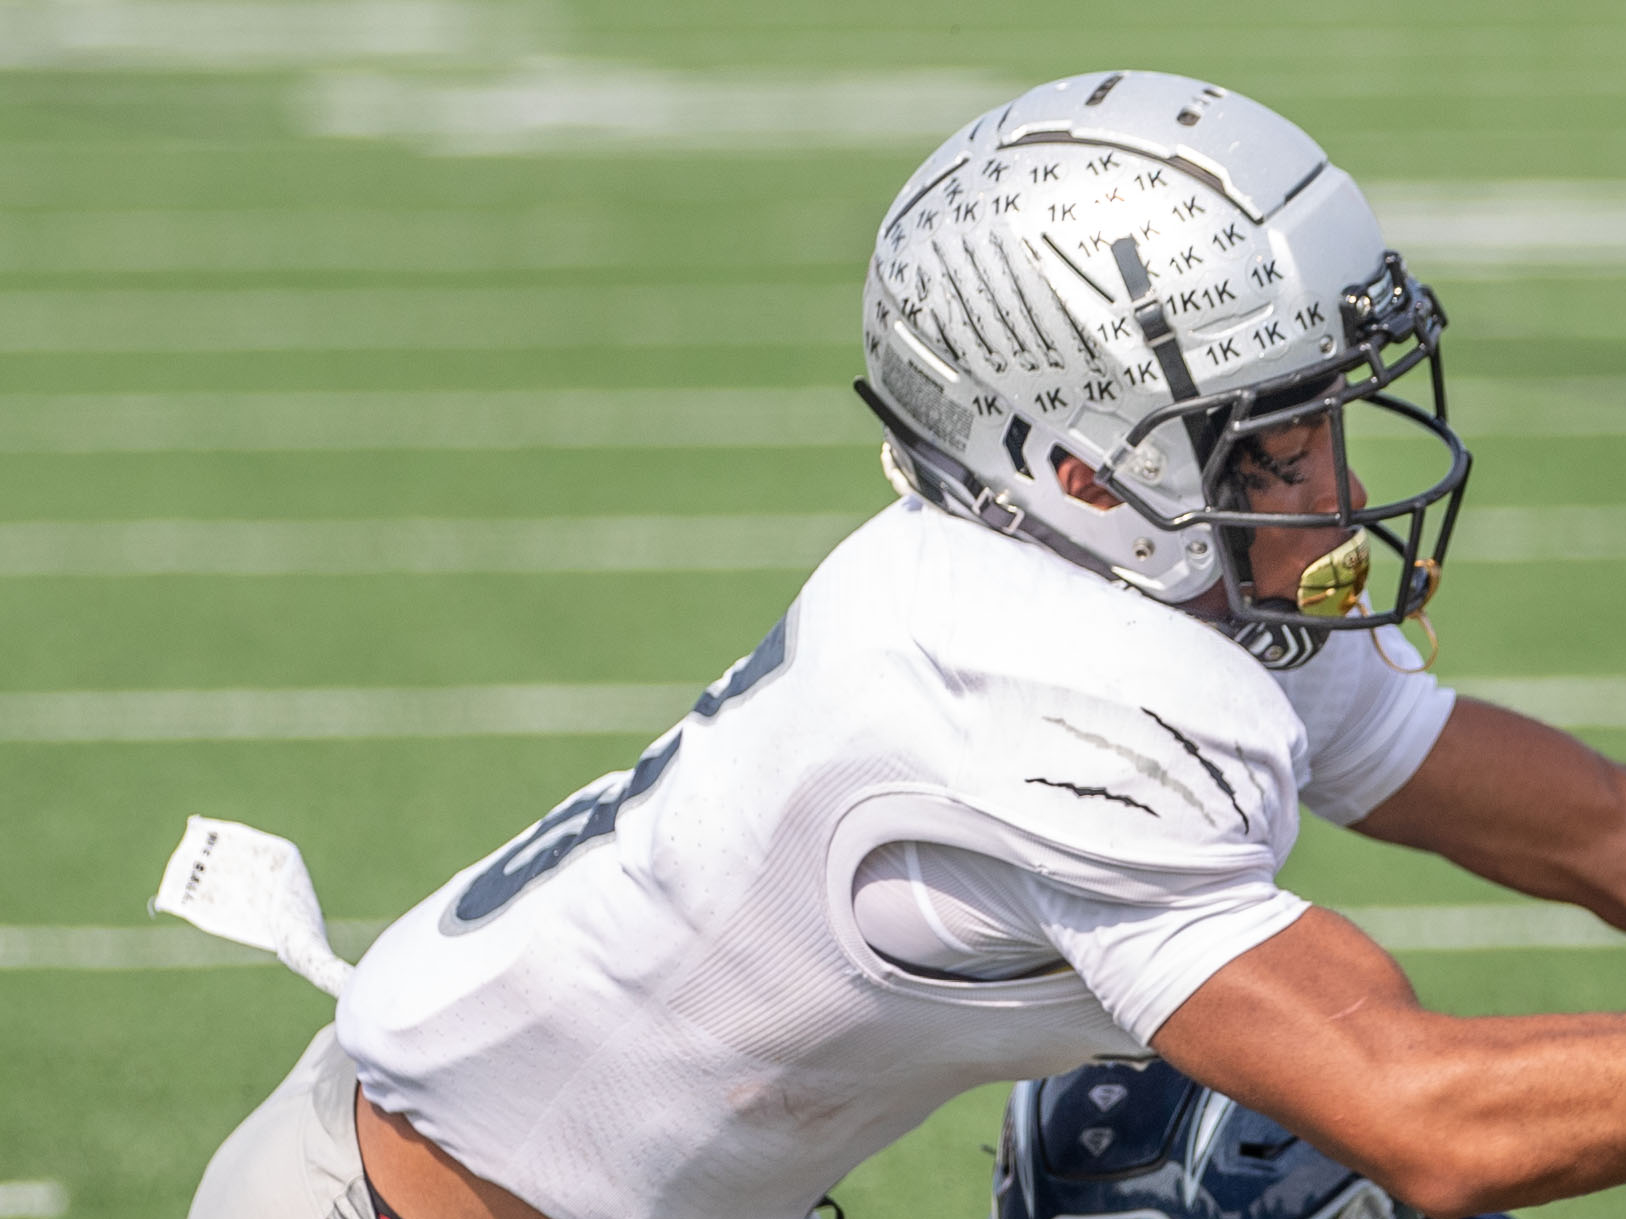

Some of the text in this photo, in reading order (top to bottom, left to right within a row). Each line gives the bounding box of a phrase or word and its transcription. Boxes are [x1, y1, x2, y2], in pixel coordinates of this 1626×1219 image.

[1030, 163, 1060, 184] 1K
[1087, 152, 1120, 176] 1K
[1135, 169, 1168, 191] 1K
[953, 201, 979, 223] 1K
[992, 193, 1021, 215] 1K
[1048, 203, 1077, 223] 1K
[1172, 196, 1206, 222] 1K
[1078, 231, 1113, 258] 1K
[1212, 223, 1246, 251] 1K
[1170, 246, 1204, 274] 1K
[1251, 260, 1284, 288] 1K
[1166, 289, 1201, 315] 1K
[1202, 279, 1237, 309] 1K
[1098, 316, 1131, 342] 1K
[1295, 302, 1326, 331] 1K
[1253, 321, 1287, 349] 1K
[1206, 338, 1241, 366] 1K
[1123, 360, 1158, 387] 1K
[1035, 387, 1069, 413] 1K
[1083, 380, 1117, 401] 1K
[972, 396, 1002, 417] 1K
